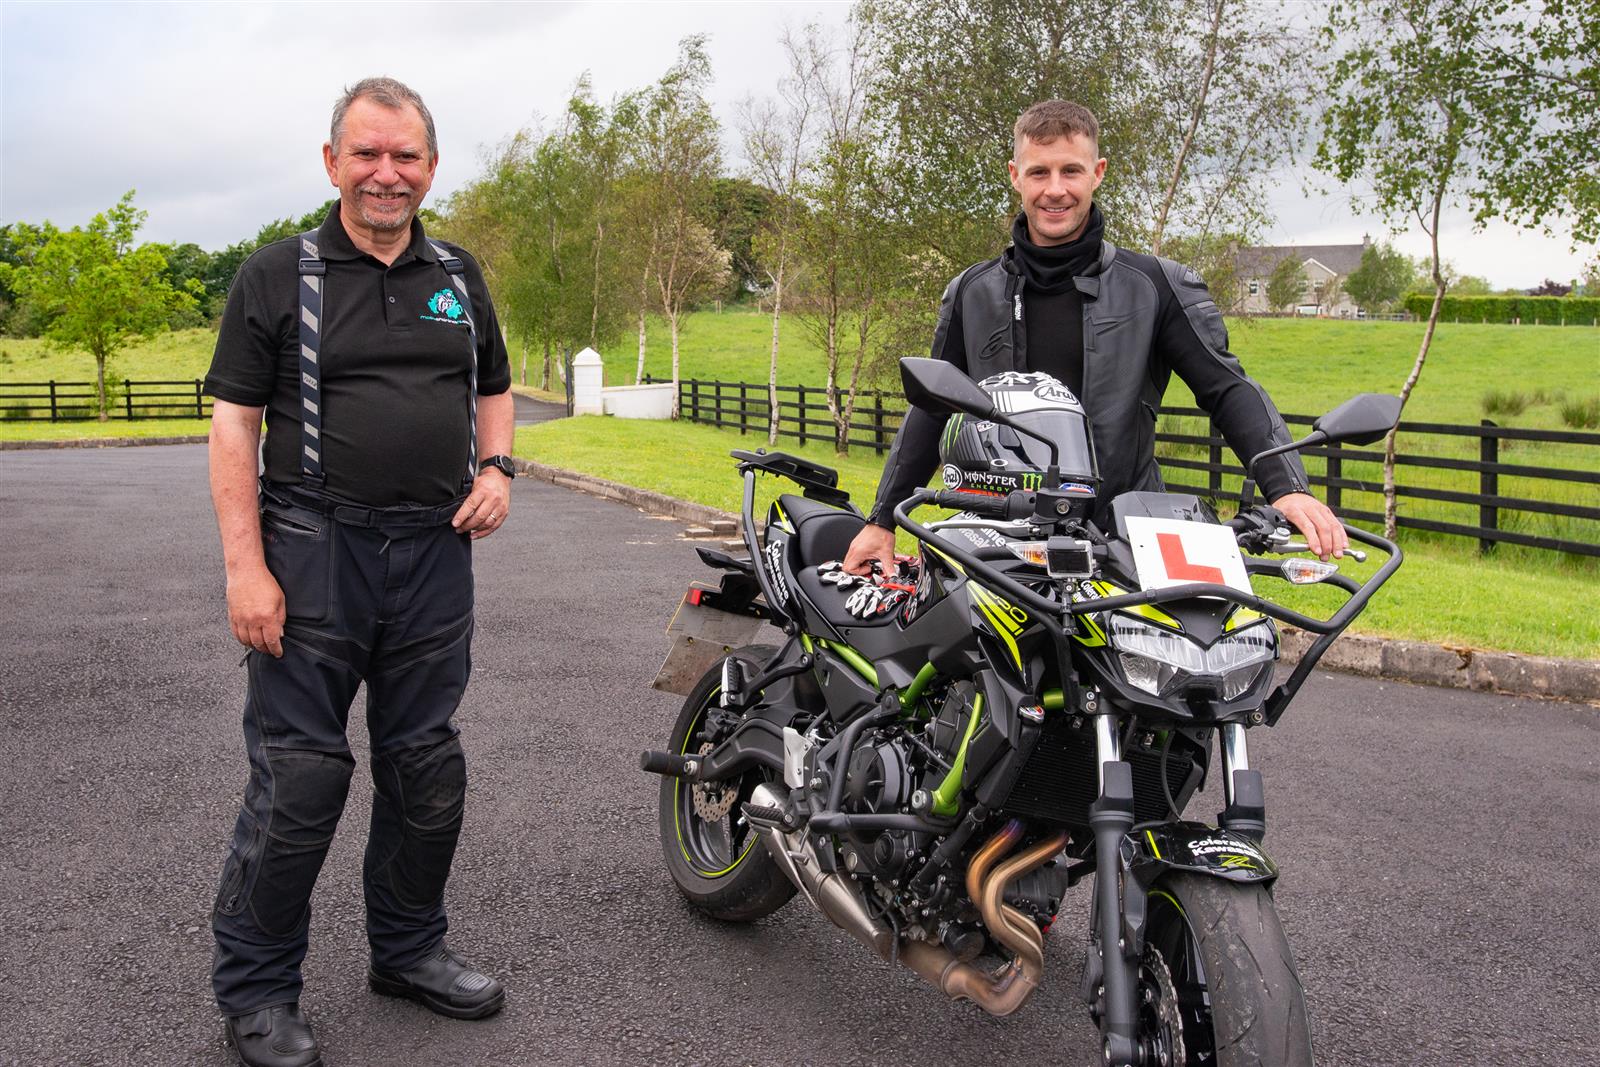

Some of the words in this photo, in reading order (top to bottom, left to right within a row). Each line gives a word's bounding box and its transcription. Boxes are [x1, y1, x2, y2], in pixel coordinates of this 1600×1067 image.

[964, 471, 1017, 488] MONSTER
[970, 483, 1010, 492] ENERGY
[1156, 532, 1226, 586] L
